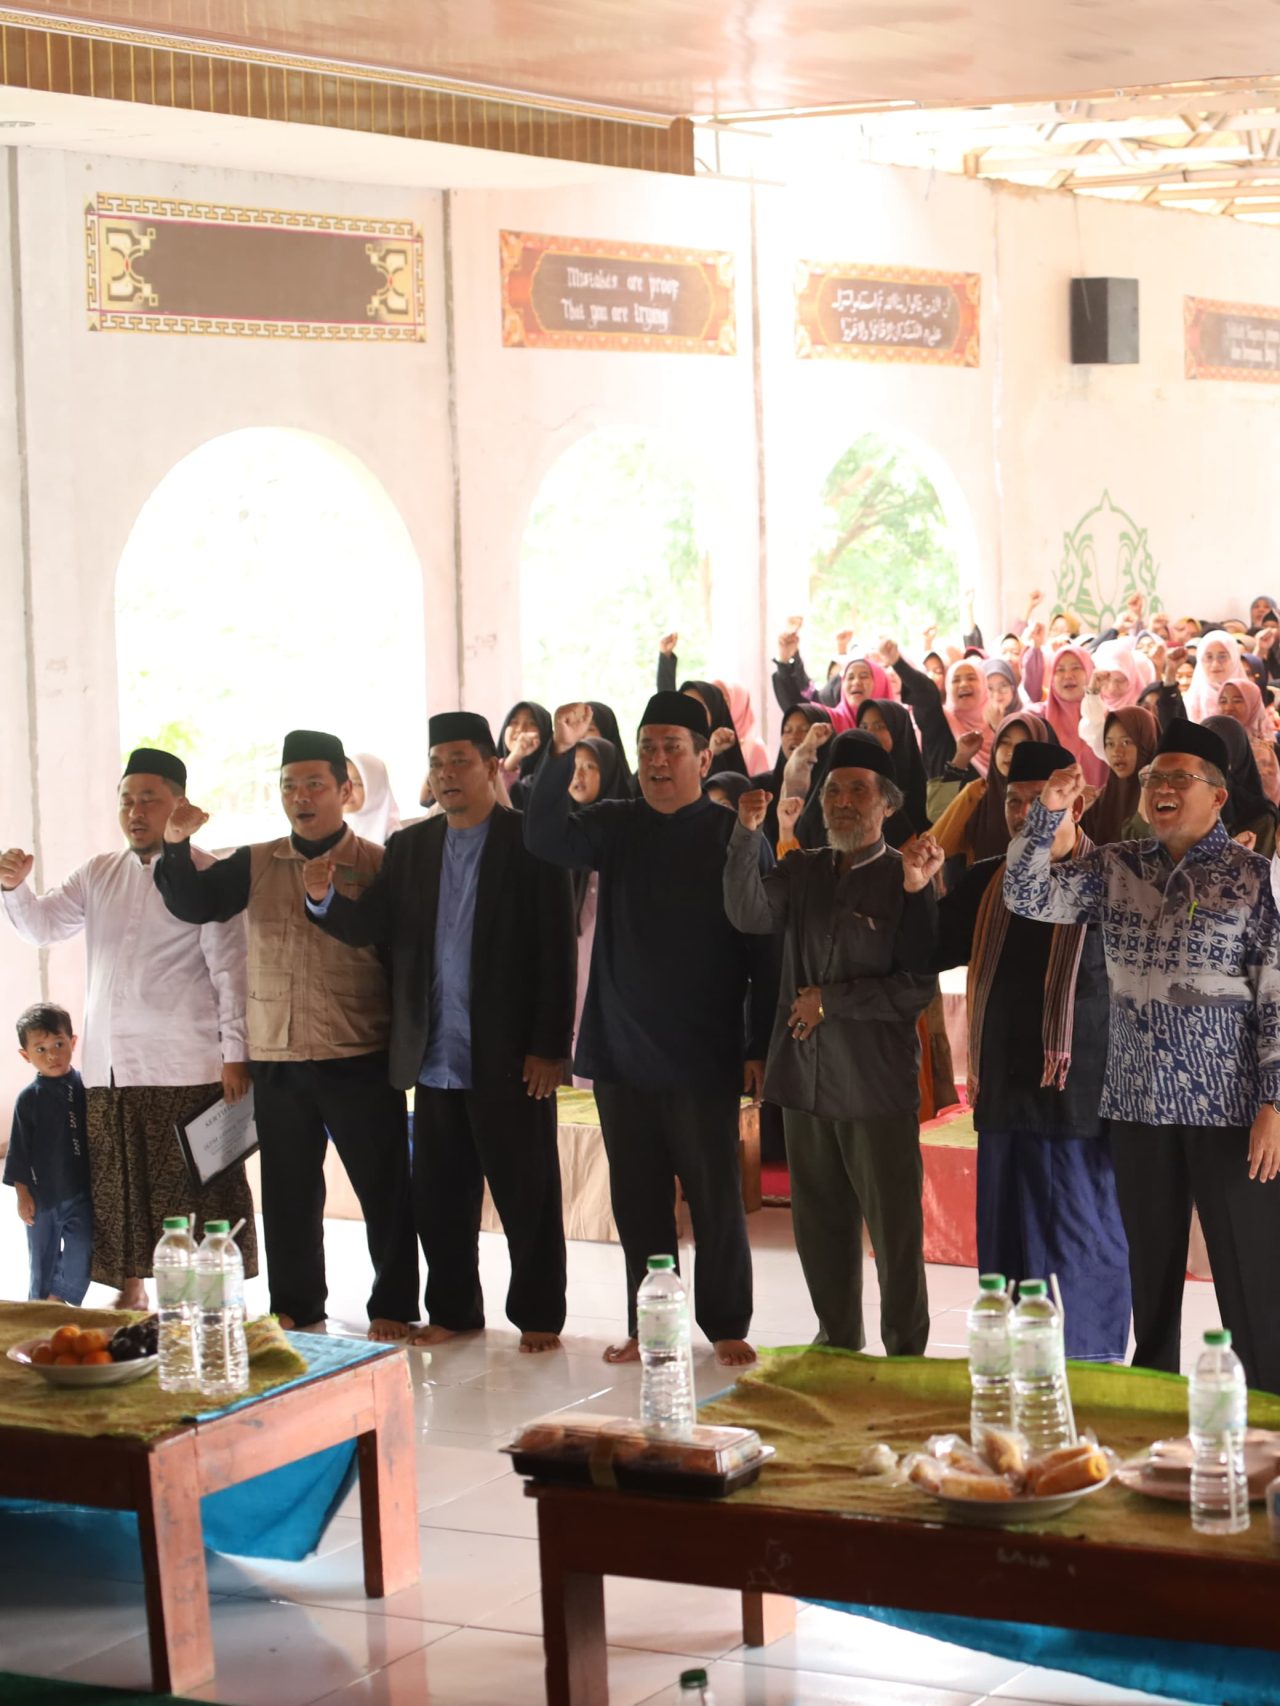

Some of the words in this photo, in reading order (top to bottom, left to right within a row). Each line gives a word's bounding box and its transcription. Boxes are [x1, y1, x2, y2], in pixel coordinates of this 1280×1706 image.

[627, 275, 643, 292] are
[560, 297, 585, 321] That
[588, 304, 608, 329] you
[611, 306, 628, 323] are
[633, 302, 671, 333] trying
